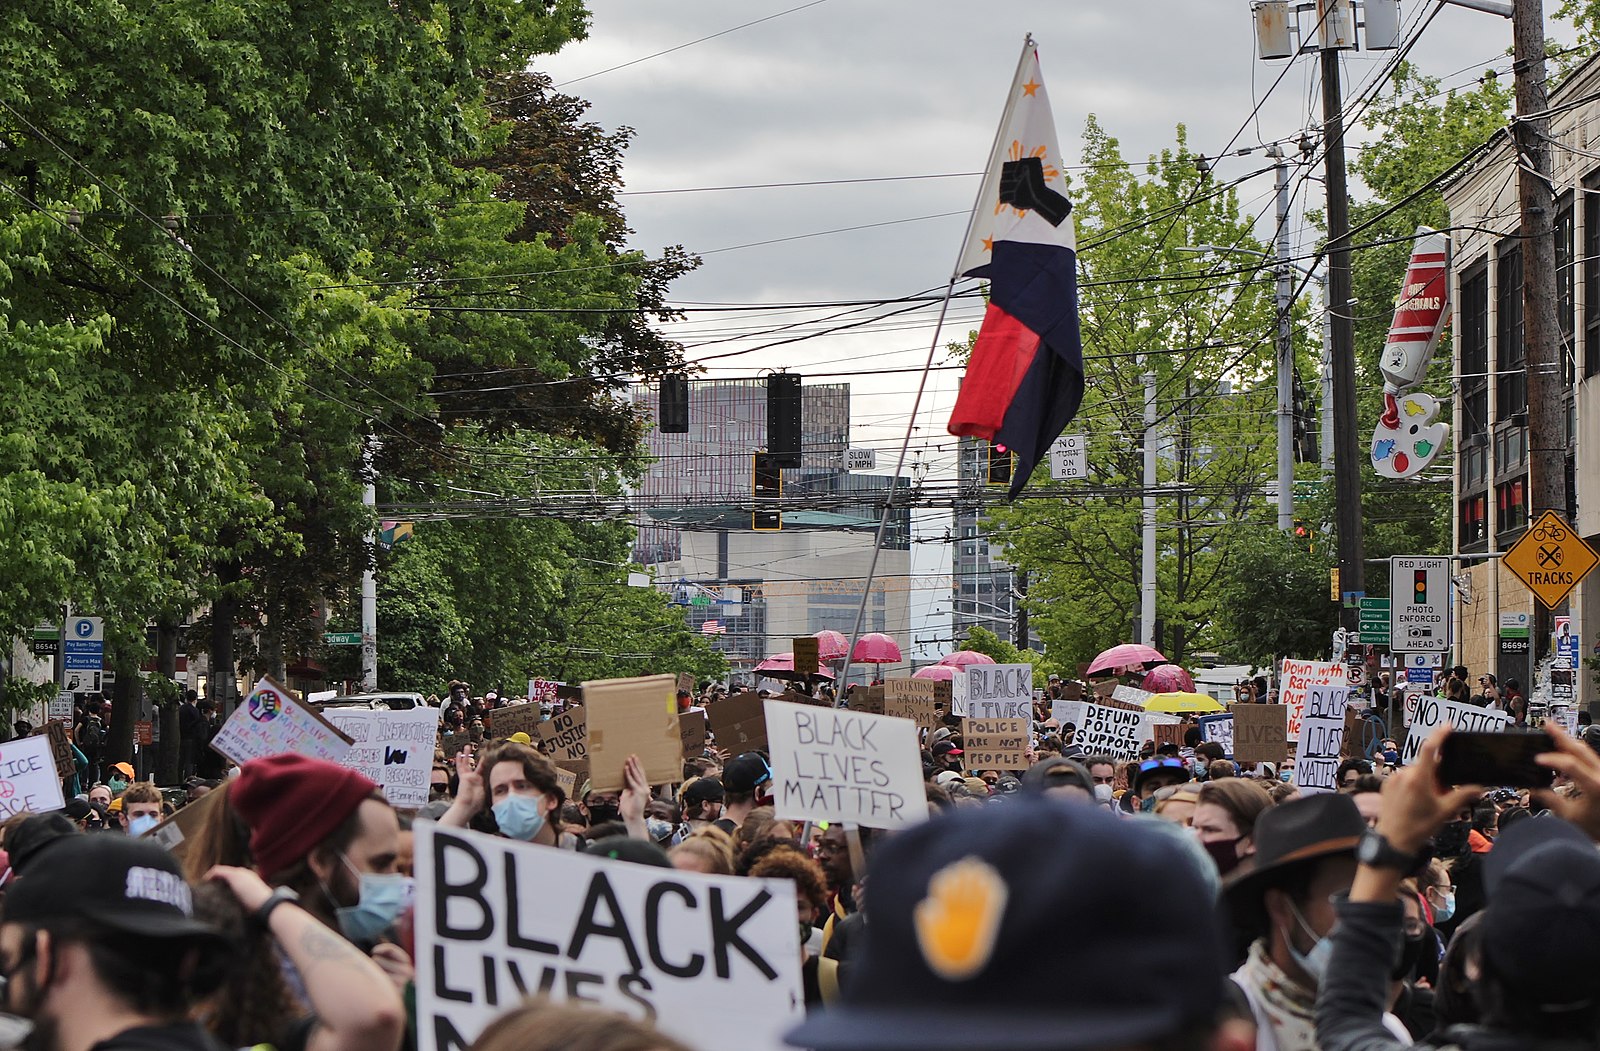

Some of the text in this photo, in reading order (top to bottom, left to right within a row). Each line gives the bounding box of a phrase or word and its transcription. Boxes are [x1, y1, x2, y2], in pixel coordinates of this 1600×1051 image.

[1059, 438, 1076, 448] NO
[849, 451, 871, 460] SLOW
[1056, 449, 1079, 457] TURN
[848, 460, 872, 469] 5 MPH
[1063, 459, 1074, 467] ON
[1061, 468, 1078, 476] RED
[1398, 560, 1442, 569] RED LIGHT
[1527, 571, 1574, 586] TRACKS
[1406, 605, 1434, 614] PHOTO
[1399, 614, 1442, 623] ENFORCED
[1406, 640, 1434, 649] AHEAD
[1501, 641, 1527, 649] 86694
[66, 655, 72, 664] 2
[1283, 660, 1343, 677] Down with
[534, 681, 558, 689] BLACK
[887, 679, 934, 693] TOLERATING
[969, 668, 1031, 700] BLACK
[896, 692, 929, 707] RACISM
[1310, 690, 1349, 717] BLACK
[492, 707, 532, 719] Everyone
[904, 704, 914, 714] IS
[1086, 705, 1140, 726] DEFUND
[1413, 698, 1439, 727] NO
[553, 714, 573, 733] NO
[968, 721, 1018, 733] POLICE
[1084, 718, 1136, 740] POLICE
[546, 722, 587, 753] JUSTIC
[795, 711, 878, 752] BLACK
[1236, 725, 1285, 743] LIVES
[967, 735, 1022, 747] ARE NOT
[1075, 729, 1140, 751] SUPPORT
[1305, 727, 1343, 757] LIVES
[567, 742, 586, 759] NO
[970, 753, 1020, 765] PEOPLE
[793, 751, 890, 787] LIVES
[1299, 761, 1339, 787] MATTER
[783, 780, 905, 821] MATTER
[432, 831, 779, 981] BLACK
